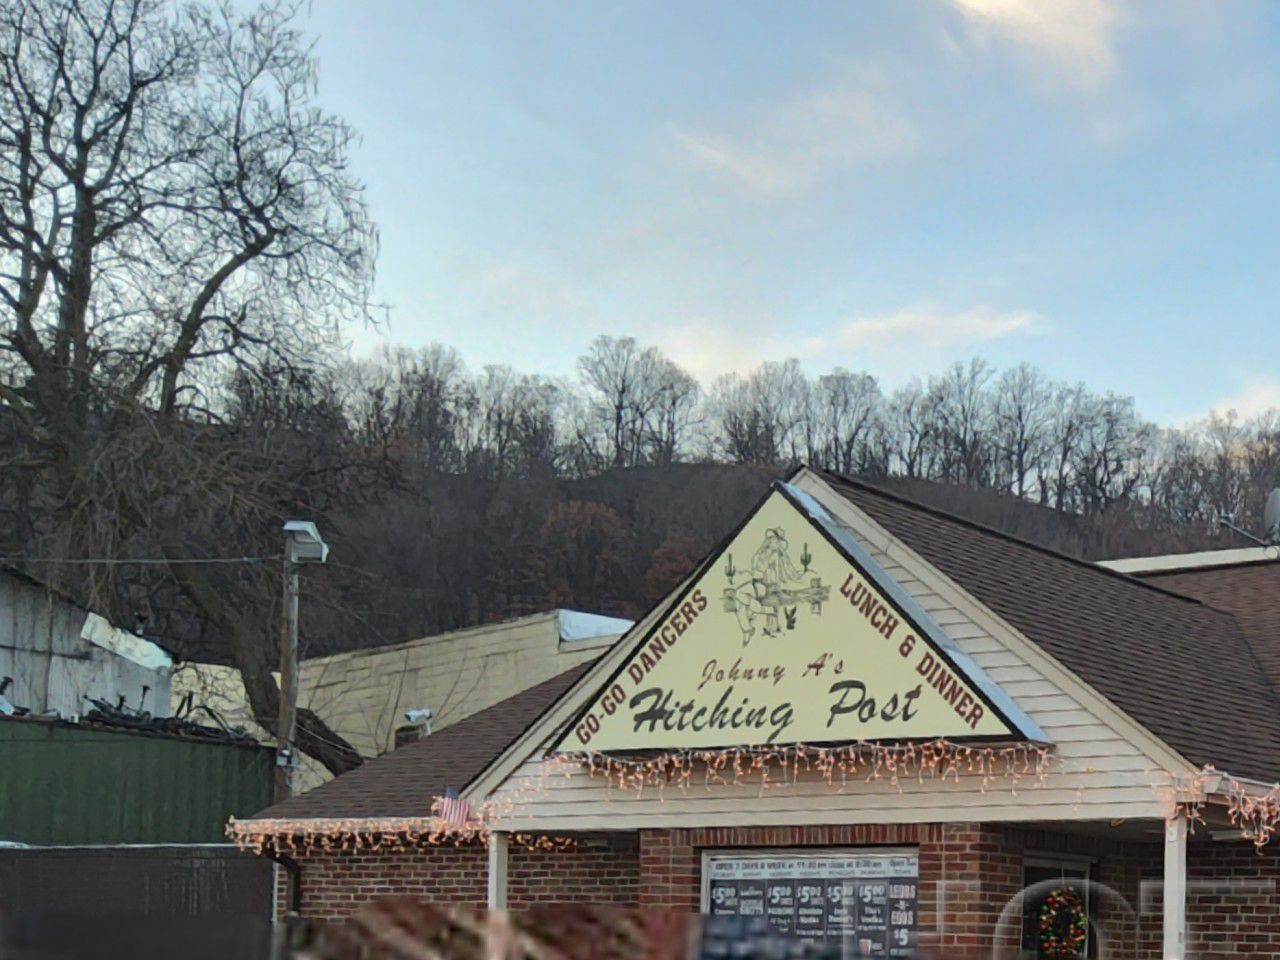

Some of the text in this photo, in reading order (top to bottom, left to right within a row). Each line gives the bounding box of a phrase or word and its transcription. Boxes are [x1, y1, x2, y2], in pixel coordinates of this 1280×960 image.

[575, 589, 708, 745] GO-GO DANCERS
[698, 652, 844, 690] Johnny A's
[839, 573, 984, 730] LUNCH & DINNER
[629, 680, 923, 743] Hitching Post
